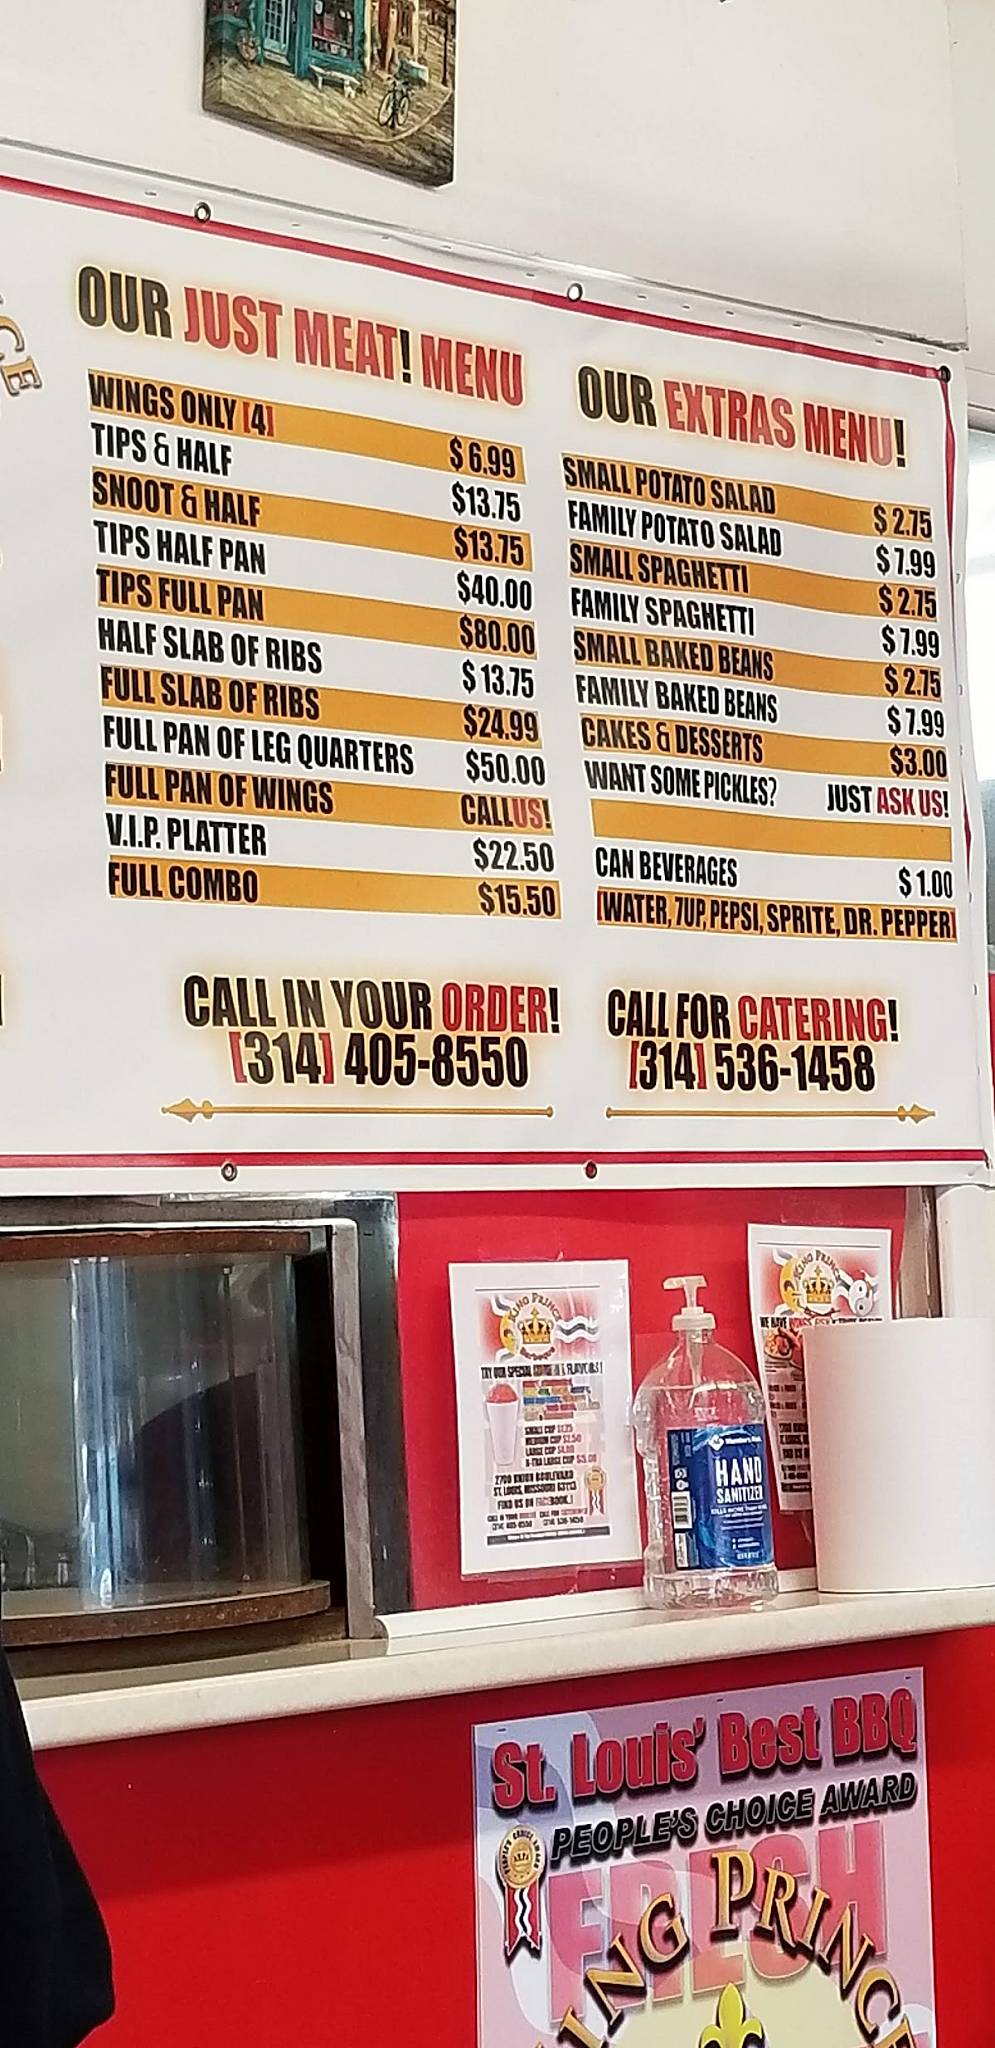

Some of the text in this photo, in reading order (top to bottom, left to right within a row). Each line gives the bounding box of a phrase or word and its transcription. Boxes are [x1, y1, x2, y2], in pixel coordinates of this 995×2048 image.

[79, 266, 523, 406] OUR JUST MEAT! MENU
[89, 373, 174, 417] WINGS
[181, 390, 238, 430] ONLY
[578, 366, 906, 467] OUR EXTRAS MENU!
[91, 422, 232, 477] TIPS & HALF
[93, 471, 261, 527] SNOOT & HALF
[451, 481, 521, 521] $13.75
[562, 457, 776, 514] SMALL POTATO SALAD
[93, 520, 267, 576] TIPS HALF PAN
[454, 526, 524, 566] $13.75
[567, 500, 782, 557] FAMILY POTATO SALAD
[457, 570, 533, 611] $40.00
[570, 543, 749, 593] SMALL SPAGHETTI
[97, 568, 263, 621] TIPS FULL PAN
[571, 587, 754, 636] FAMILY SPAGHETTI
[98, 618, 321, 675] HALF SLAB OF RIBS
[460, 614, 535, 655] $80.00
[573, 630, 774, 681] SMALL BAKED BEANS
[101, 666, 319, 720] FULL SLAB OF RIBS
[576, 674, 778, 723] FAMILY BAKED BEANS
[103, 715, 414, 775] FULL PAN OF LEG QUARTERS
[463, 705, 539, 741] $24.99
[582, 718, 763, 763] CAKES & DESSERTS
[465, 749, 546, 787] $50.00
[585, 760, 777, 807] WANT SOME PICKLES?
[889, 744, 947, 778] $3.00
[105, 764, 333, 815] FULL PAN OF WINGS
[827, 783, 949, 818] JUST ASK US!
[106, 814, 267, 857] V.I.P. PLATTER
[473, 837, 554, 872] $22.50
[108, 863, 258, 903] FULL COMBO
[595, 847, 738, 888] CAN BEVERAGES
[478, 881, 557, 918] $15.50
[710, 897, 764, 934] PEPSI,
[767, 903, 841, 939] SPRITE,
[844, 908, 878, 936] DR.
[184, 975, 560, 1034] CALL IN YOUR ORDER!
[607, 989, 899, 1042] CALL FOR CATERING!
[344, 1033, 529, 1088] 405-8550
[715, 1043, 876, 1092] 536-1458
[715, 1456, 762, 1487] HAND
[494, 1688, 917, 1812] St. Louis' Best BBQ
[552, 1773, 917, 1864] PEOPLE'S CHOICE AWARD
[547, 1820, 889, 2022] FRESH
[553, 1891, 688, 2048] ING
